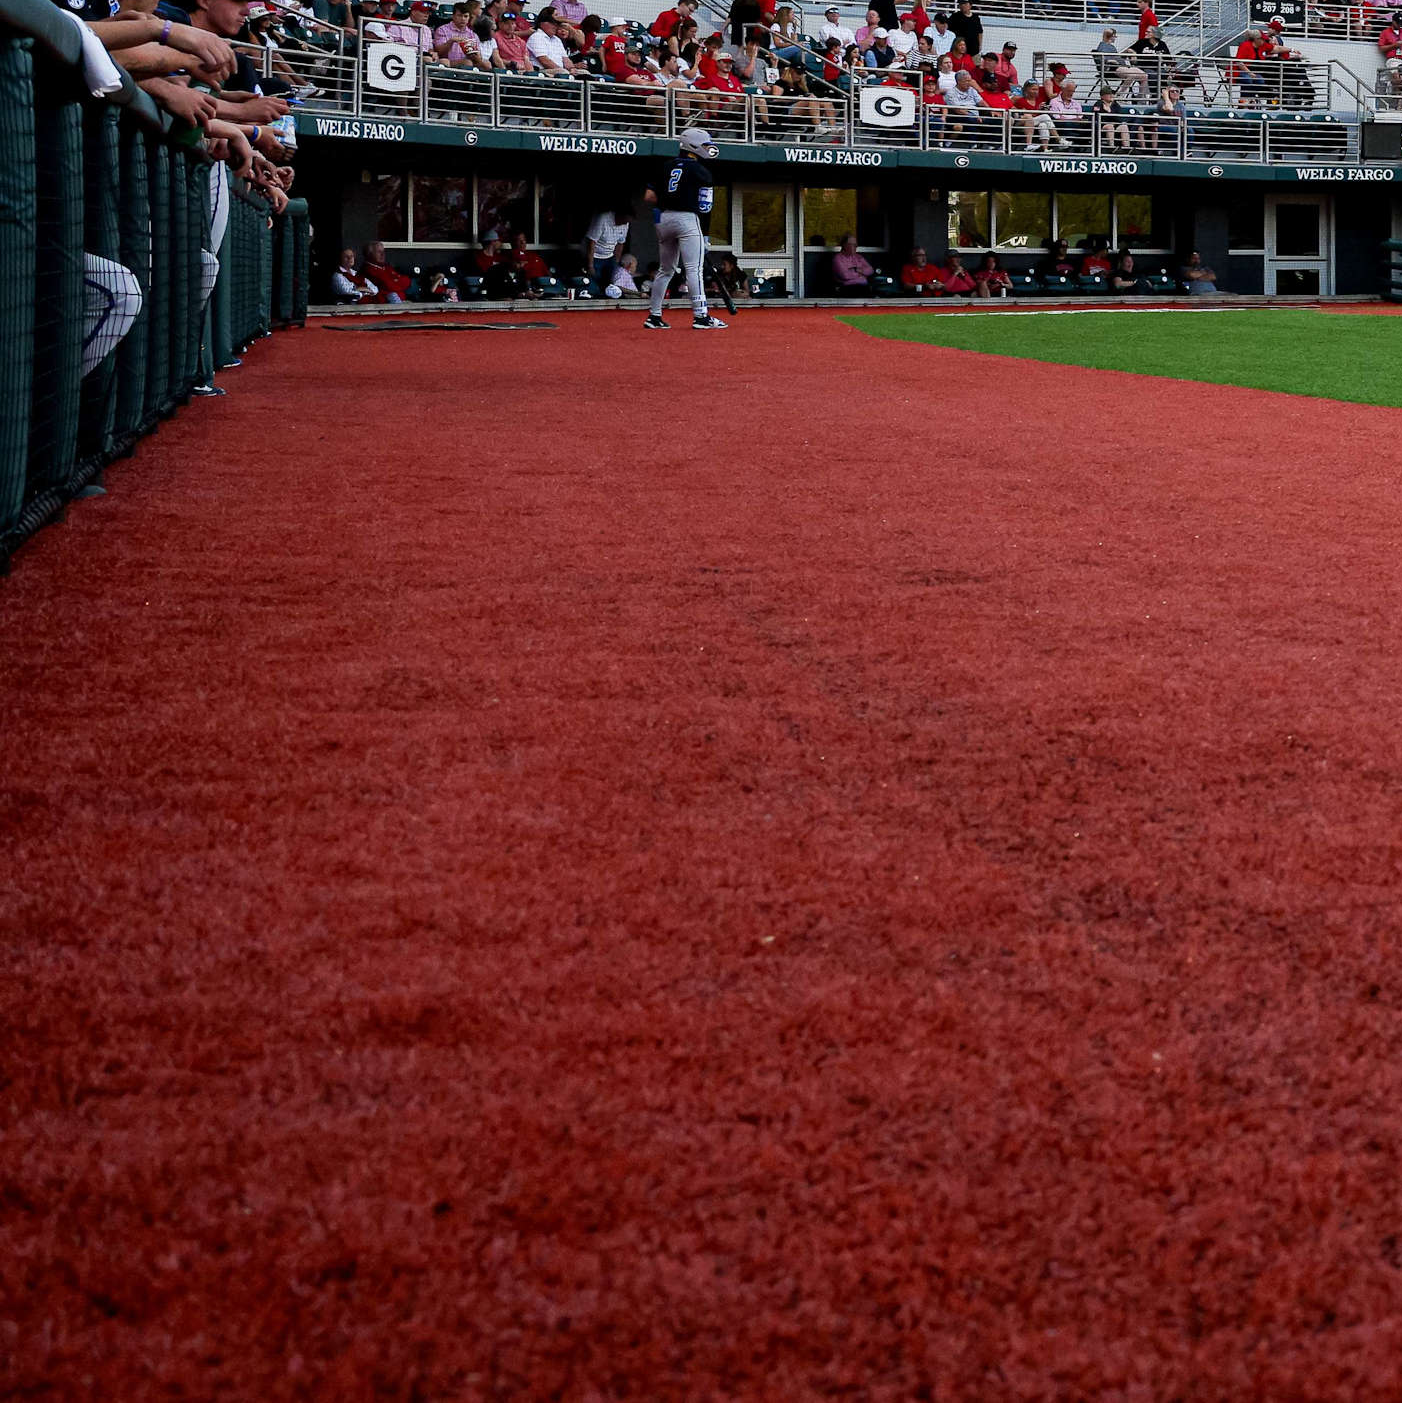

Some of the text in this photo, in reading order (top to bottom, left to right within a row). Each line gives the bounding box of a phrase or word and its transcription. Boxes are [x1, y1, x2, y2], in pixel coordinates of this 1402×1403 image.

[1262, 5, 1295, 14] 207 208
[381, 55, 405, 80] G
[874, 96, 902, 117] G
[316, 118, 405, 142] WELLS FARGO
[539, 135, 637, 155] WELLS FARGO
[784, 147, 882, 166] WELLS FARGO
[1039, 160, 1138, 175] WELLS FARGO
[1296, 168, 1394, 181] WELLS FARGO
[669, 168, 683, 192] 2
